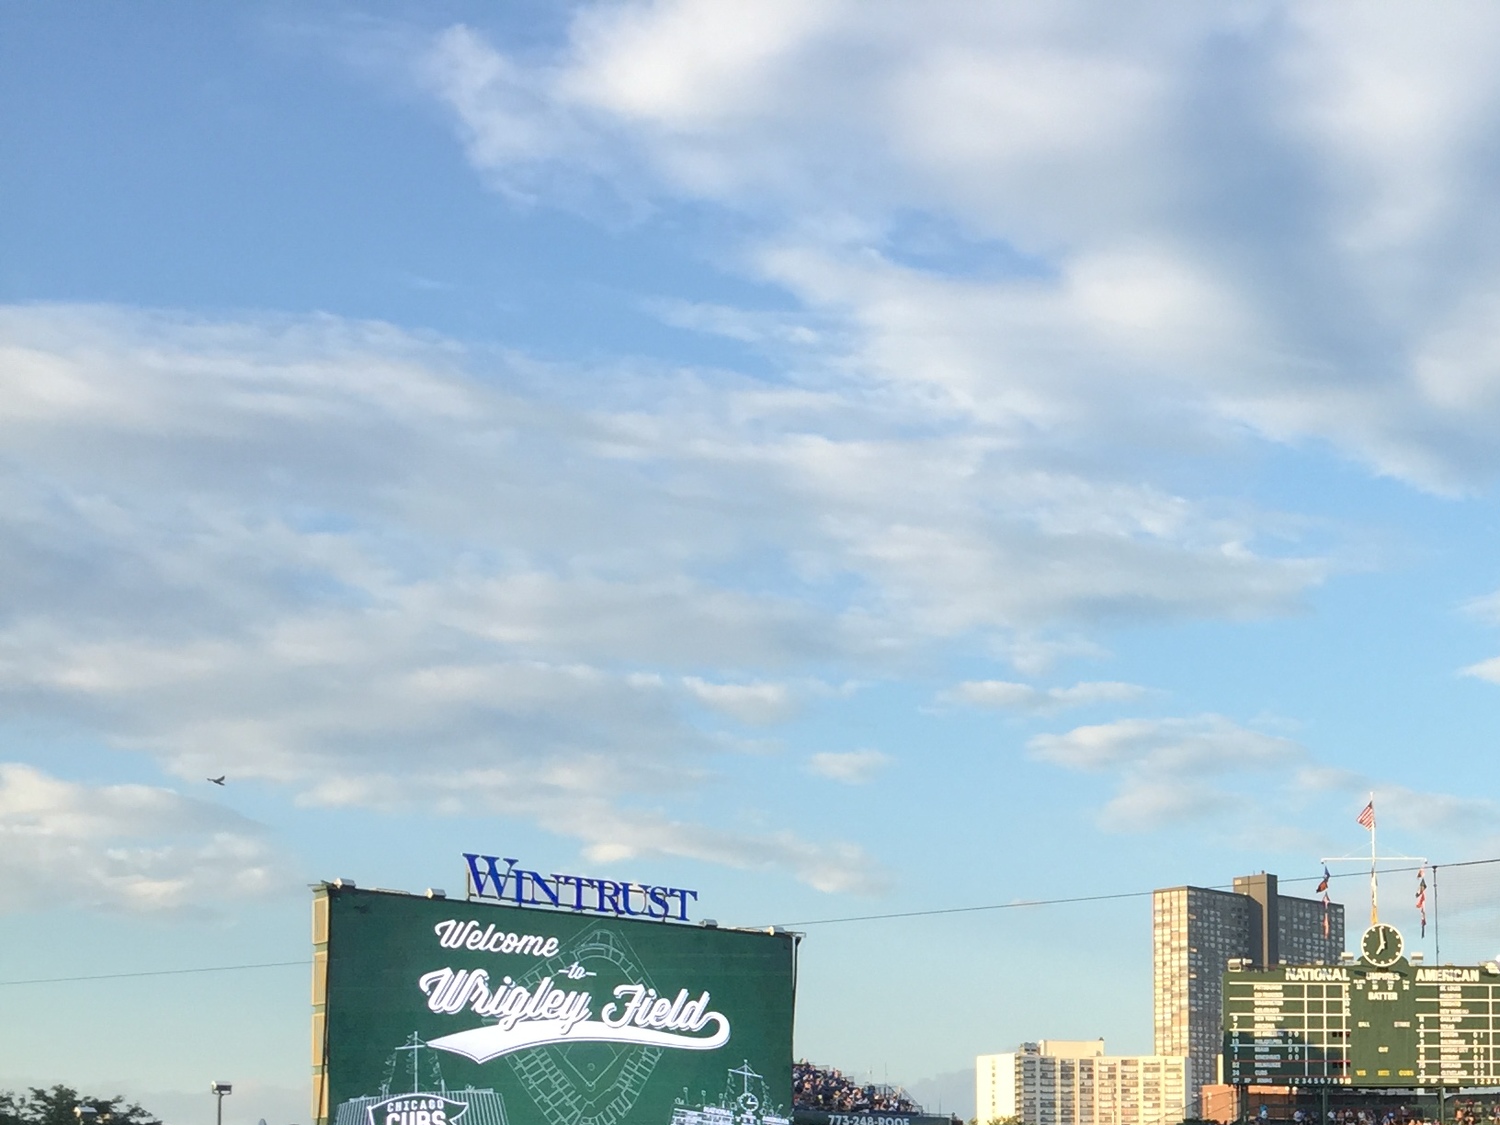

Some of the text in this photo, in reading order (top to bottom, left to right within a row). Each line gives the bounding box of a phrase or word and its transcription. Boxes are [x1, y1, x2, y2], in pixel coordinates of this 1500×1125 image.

[462, 853, 697, 922] WINTRUST
[434, 919, 559, 958] Welcome
[1285, 967, 1350, 981] NATIONAL
[1365, 971, 1400, 981] UMPIRES
[1415, 968, 1480, 982] AMERICAN
[419, 966, 710, 1036] Wrigley Field
[1368, 992, 1398, 1000] BATTER
[387, 1099, 444, 1113] CHICAGO
